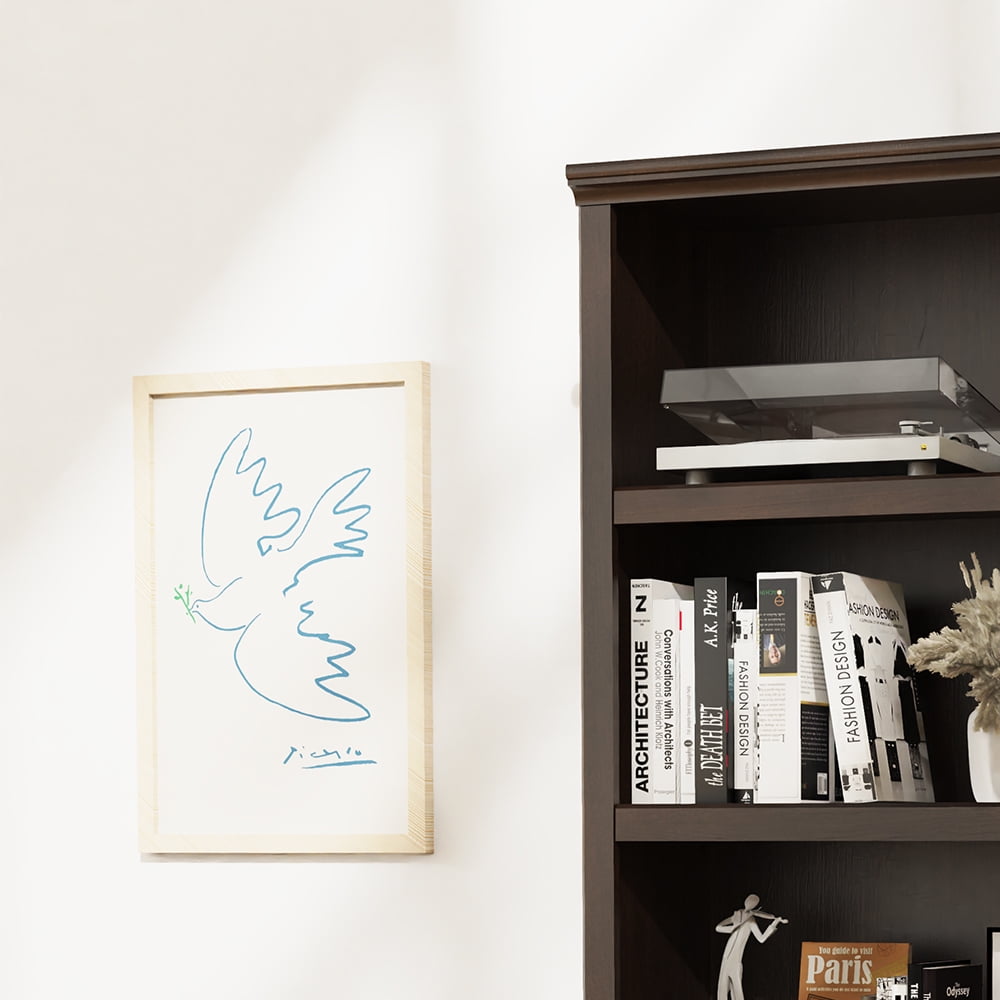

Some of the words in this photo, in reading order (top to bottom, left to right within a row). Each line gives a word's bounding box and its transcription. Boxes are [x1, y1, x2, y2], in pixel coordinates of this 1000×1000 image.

[703, 588, 718, 617] Price
[847, 602, 875, 617] ASHION
[875, 606, 900, 621] DESIGN
[655, 631, 663, 649] John
[664, 629, 673, 697] Conversations
[830, 631, 851, 680] DESIGN
[655, 682, 663, 698] and
[739, 660, 749, 711] FASHION
[635, 641, 649, 793] ARCHITECTURE
[655, 700, 663, 730] Heinrich
[664, 700, 673, 720] with
[699, 703, 723, 727] BET
[839, 684, 860, 743] FASHION
[655, 732, 663, 750] Klotz
[664, 722, 673, 770] Architects
[699, 729, 723, 770] DEATH
[739, 714, 749, 756] DESIGN
[704, 772, 724, 786] the
[805, 954, 873, 985] Paris
[910, 983, 919, 999] THE
[946, 986, 970, 998] Odyssey
